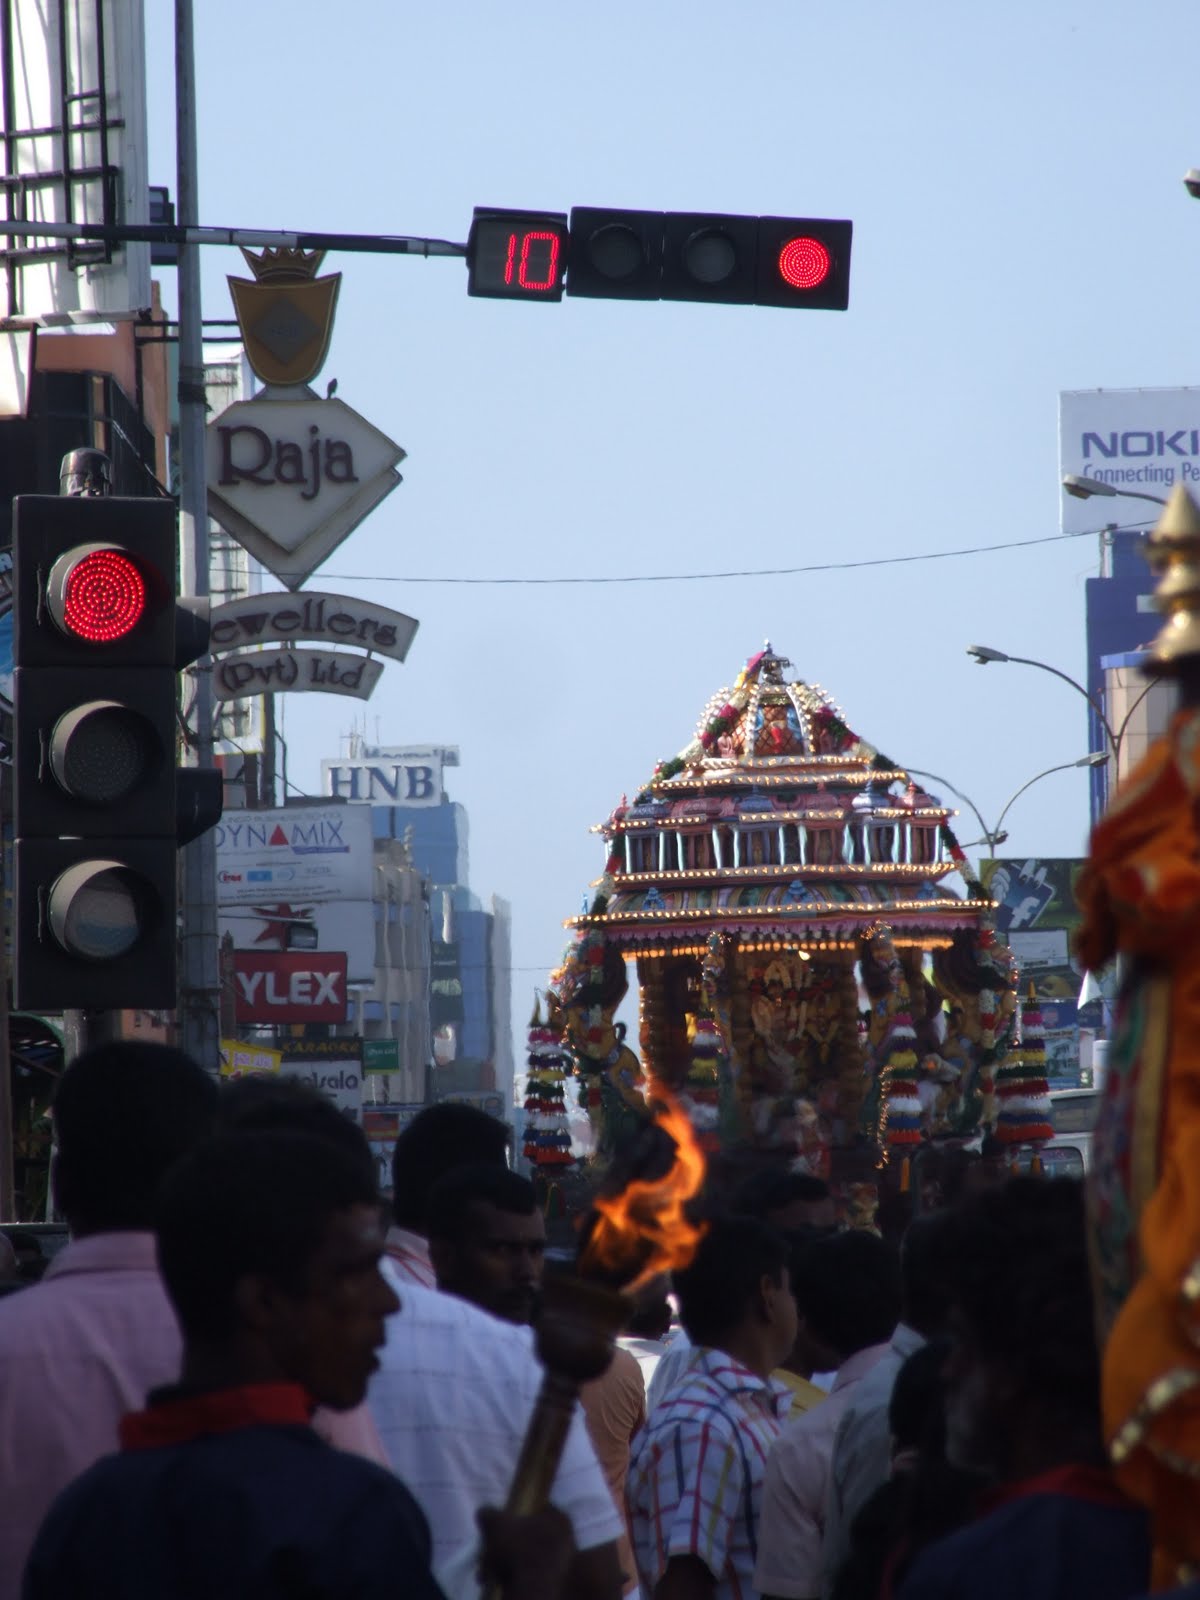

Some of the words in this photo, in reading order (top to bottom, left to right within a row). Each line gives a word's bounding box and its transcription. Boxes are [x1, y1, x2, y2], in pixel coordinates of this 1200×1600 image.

[504, 231, 560, 291] 10
[216, 425, 359, 500] Raja
[1081, 429, 1200, 459] NOKI
[1083, 463, 1175, 487] Connecting
[210, 598, 398, 647] ewellers
[220, 655, 299, 692] (Pvt)
[311, 658, 367, 690] Ltd
[328, 764, 434, 800] HNB
[236, 970, 342, 1007] YLEX
